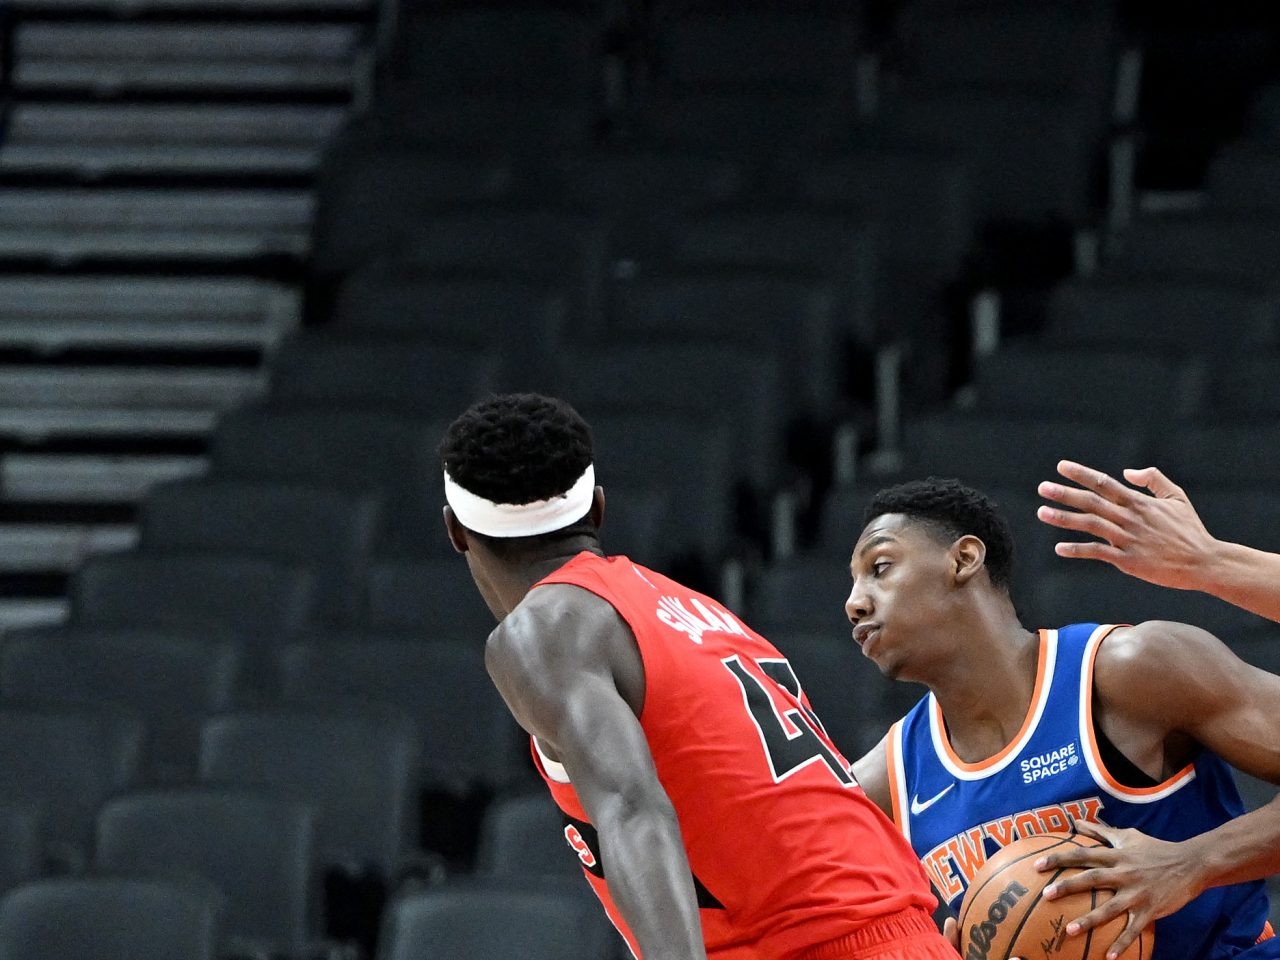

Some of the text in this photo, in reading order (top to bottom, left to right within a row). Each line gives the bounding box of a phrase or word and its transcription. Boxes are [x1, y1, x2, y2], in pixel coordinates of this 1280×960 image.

[1020, 743, 1076, 772] SQUARE
[1023, 759, 1067, 784] SPACE
[921, 825, 988, 905] NEW
